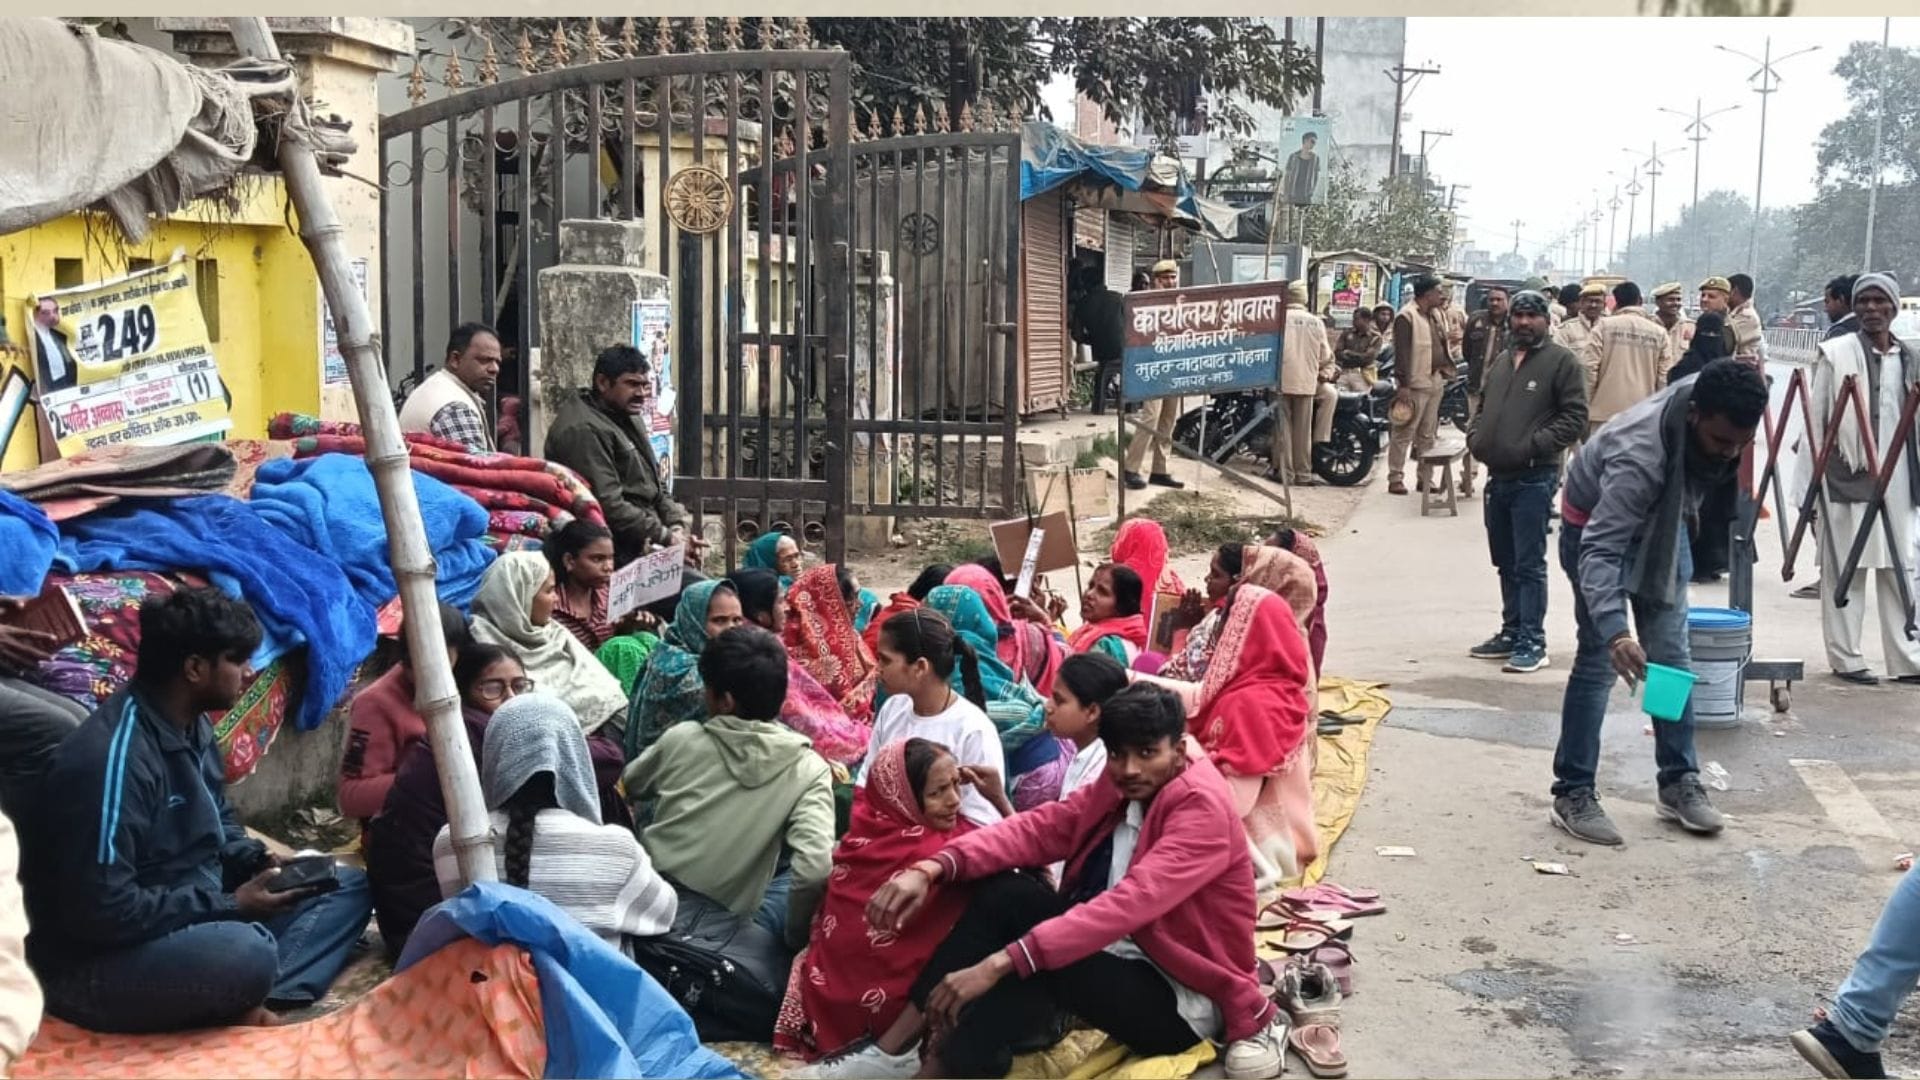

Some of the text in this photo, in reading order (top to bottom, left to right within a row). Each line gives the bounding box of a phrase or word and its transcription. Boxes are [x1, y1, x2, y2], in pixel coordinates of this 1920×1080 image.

[97, 304, 156, 362] 249
[1132, 294, 1218, 336] कार्यालय
[187, 372, 210, 402] (1)
